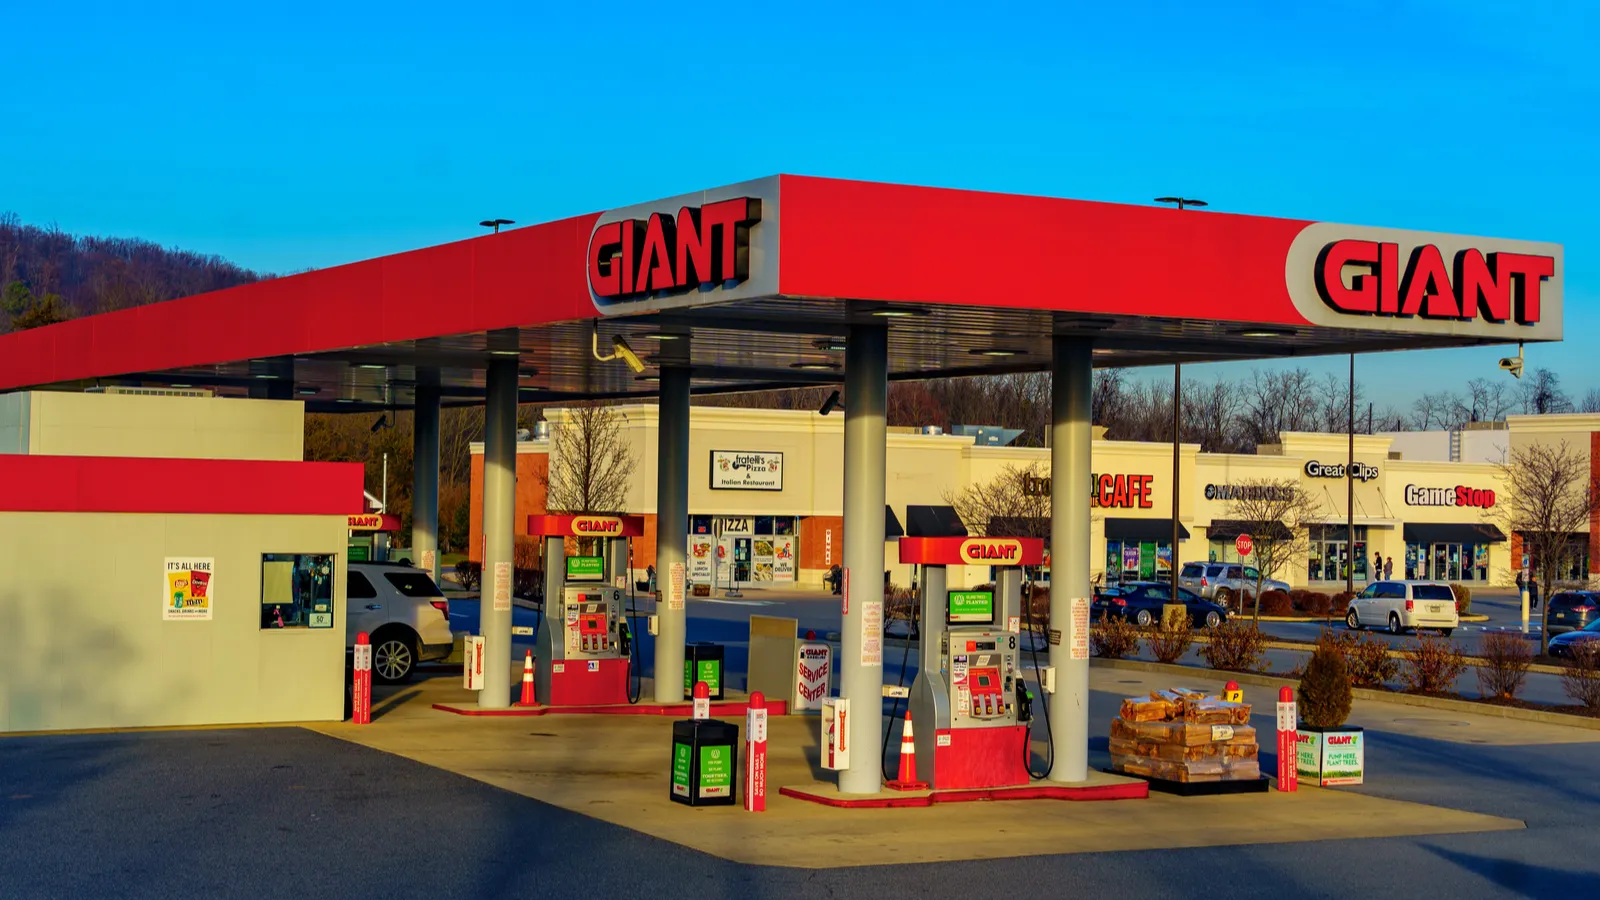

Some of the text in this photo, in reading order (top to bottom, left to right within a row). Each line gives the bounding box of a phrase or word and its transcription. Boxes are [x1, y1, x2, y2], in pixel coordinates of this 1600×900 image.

[589, 197, 762, 297] GIANT
[1314, 239, 1555, 326] GIANT
[746, 464, 766, 472] Pizza
[1304, 459, 1345, 478] Great
[1099, 474, 1153, 508] CAFE
[1405, 484, 1496, 509] GameStop
[577, 520, 618, 532] GIANT
[967, 544, 1017, 559] GIANT
[1237, 541, 1252, 550] STOP
[168, 562, 211, 570] IT'S ALL HERE
[613, 590, 620, 601] 6
[1008, 636, 1016, 650] 8
[799, 662, 828, 683] SERVICE
[799, 681, 826, 702] CENTER
[1233, 692, 1239, 701] P
[1328, 735, 1352, 745] GIANT
[754, 771, 759, 780] ON
[759, 786, 764, 797] SO
